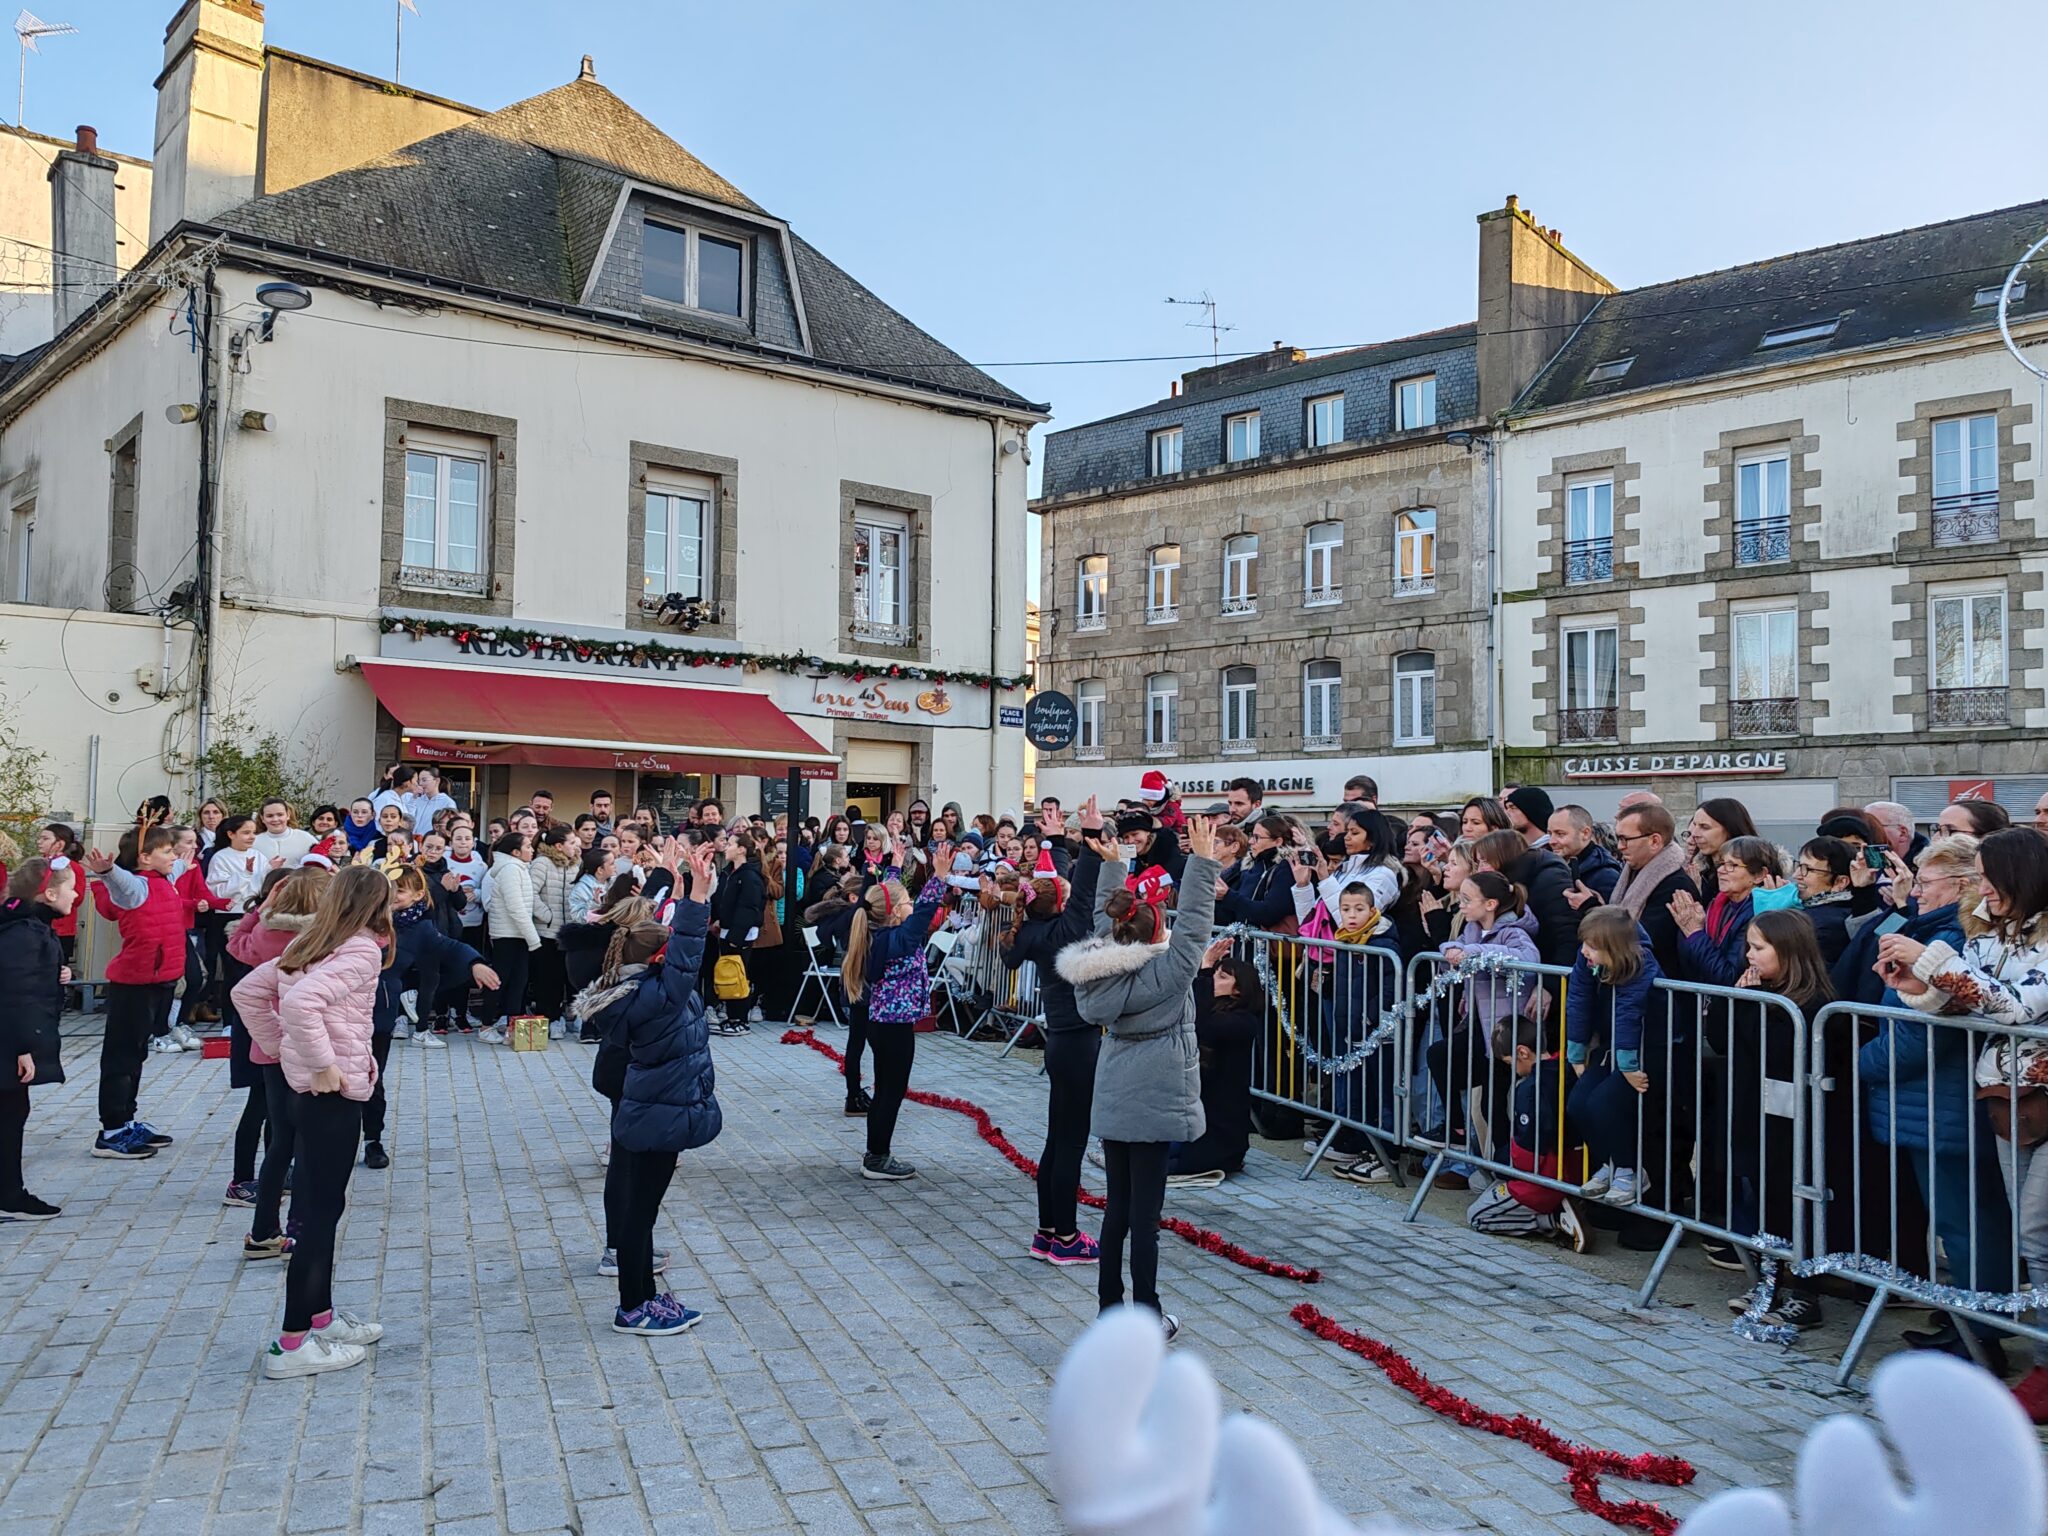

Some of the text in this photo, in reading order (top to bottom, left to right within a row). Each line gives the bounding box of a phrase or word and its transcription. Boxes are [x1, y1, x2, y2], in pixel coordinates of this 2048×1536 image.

[805, 674, 856, 707] Terre
[858, 688, 876, 702] des
[826, 707, 855, 718] Primeur
[862, 711, 889, 720] Traiteur
[1000, 709, 1020, 717] PLACE
[1034, 698, 1071, 722] boutique
[1030, 716, 1073, 732] restaurant
[416, 745, 448, 757] Traiteur
[456, 751, 487, 760] Primeur
[612, 752, 639, 768] Terre
[1564, 752, 1786, 773] CAISSE D'EPARGNE
[800, 768, 834, 777] icerie Fine
